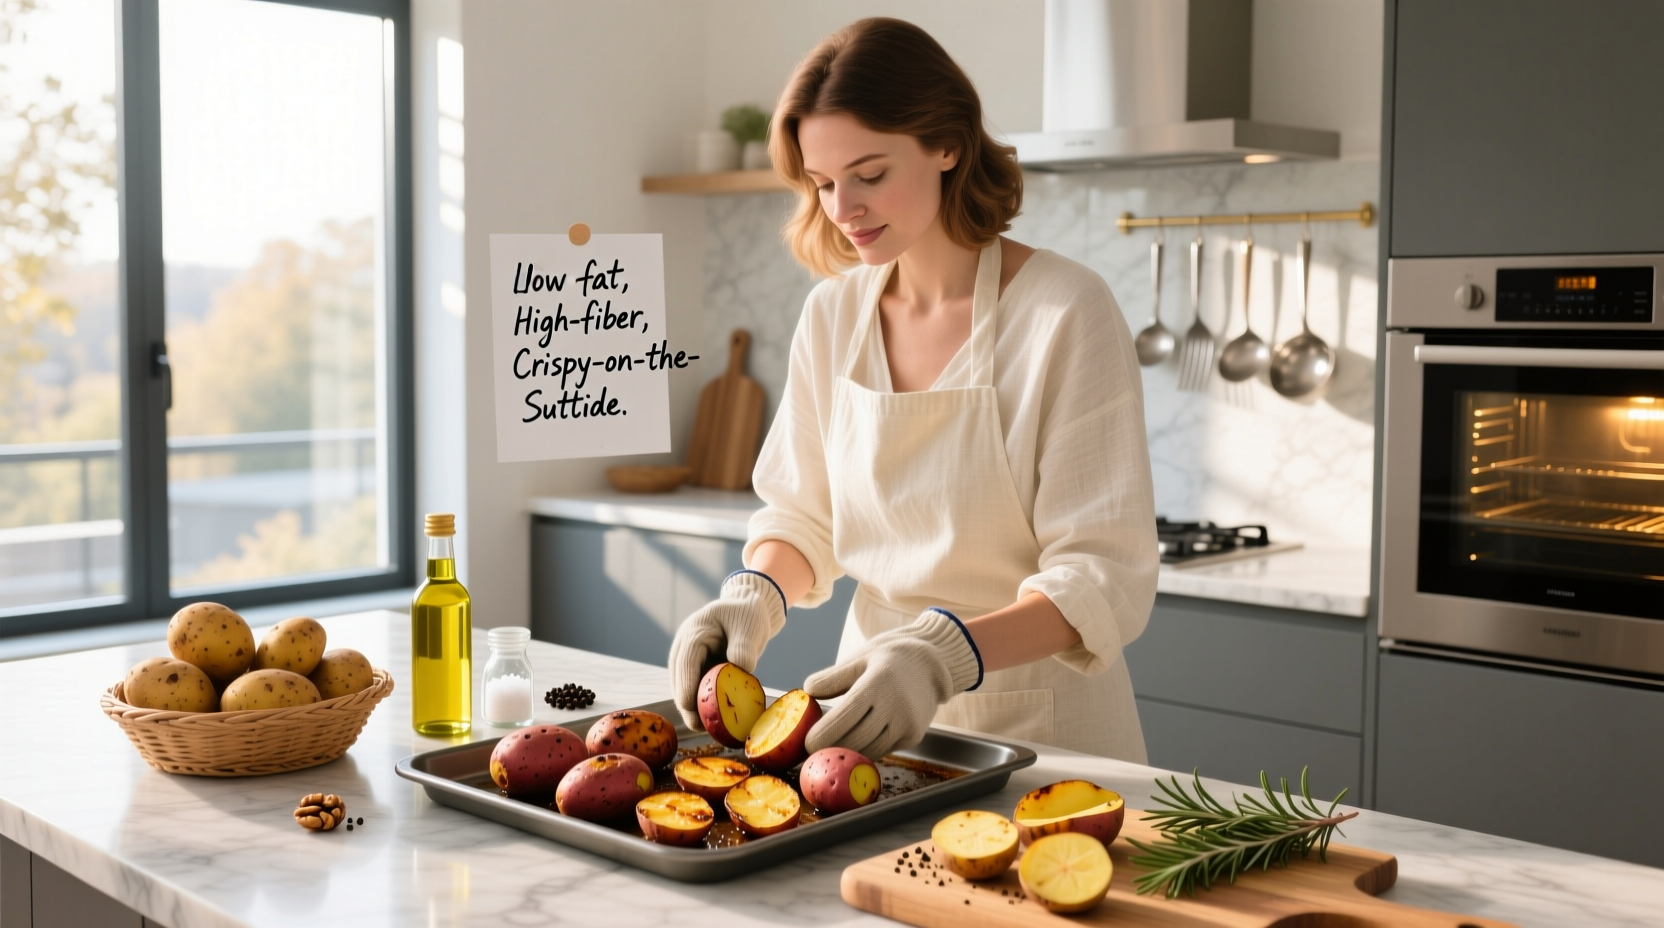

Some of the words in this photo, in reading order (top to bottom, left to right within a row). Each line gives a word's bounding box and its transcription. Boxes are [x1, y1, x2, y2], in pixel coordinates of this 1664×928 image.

[575, 259, 629, 297] fat,
[514, 299, 649, 349] High-fiber,
[513, 339, 700, 390] Crispy-on-the-
[522, 386, 628, 423] Suttide.
